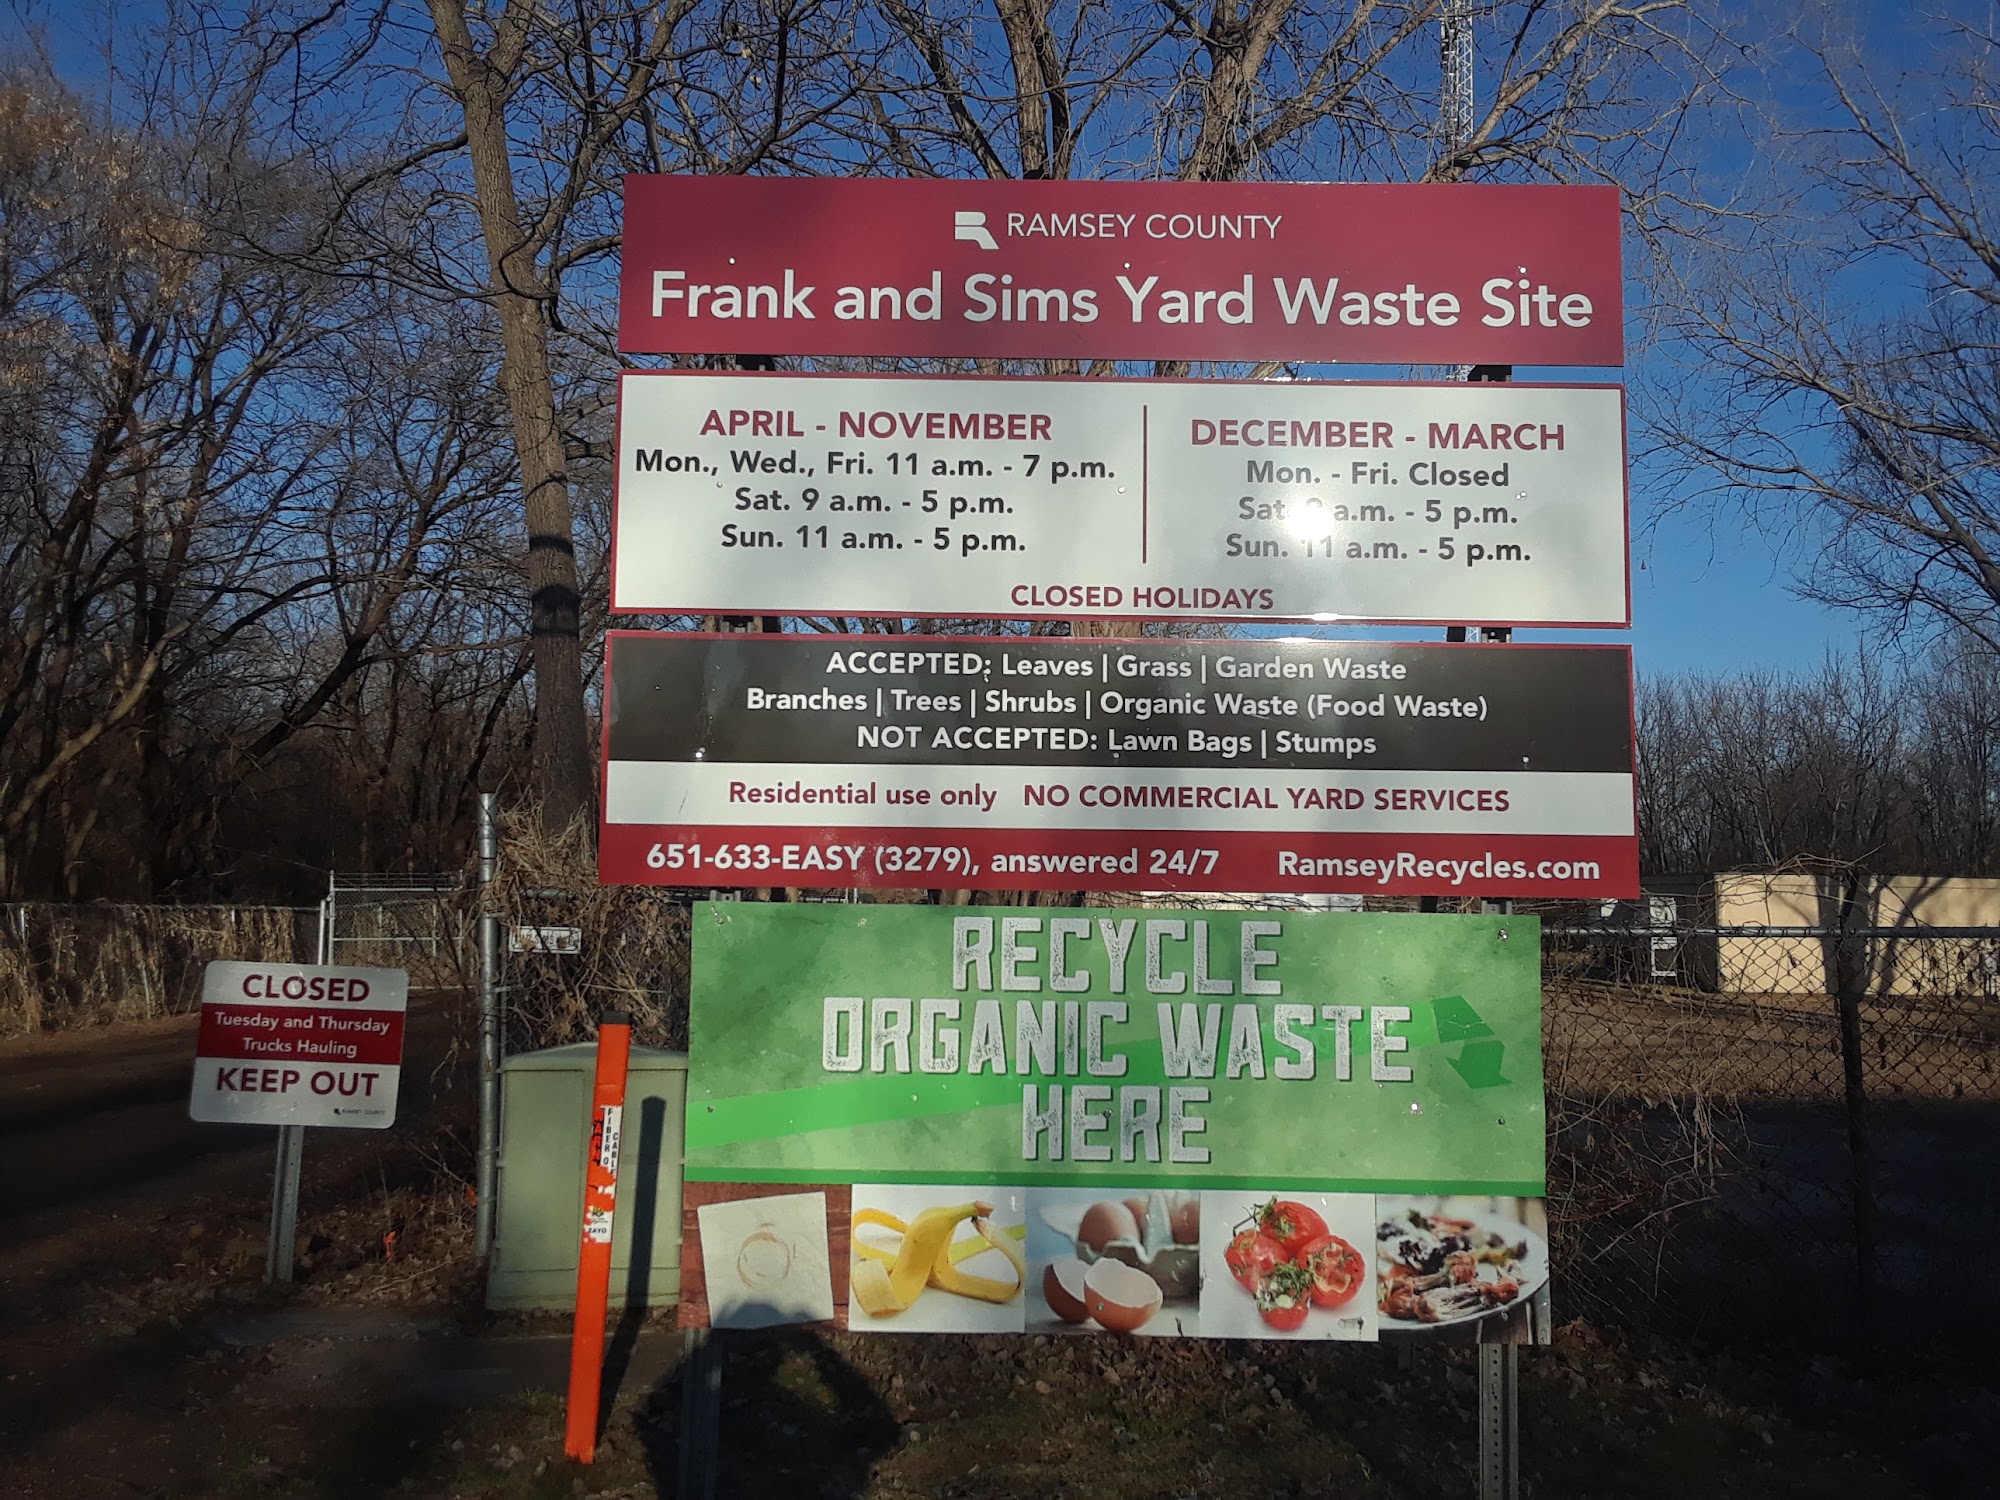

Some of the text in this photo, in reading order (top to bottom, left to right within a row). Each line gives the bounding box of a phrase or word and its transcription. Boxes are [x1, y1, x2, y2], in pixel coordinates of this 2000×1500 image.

[1009, 213, 1135, 237] RAMSEY
[1146, 214, 1282, 238] COUNTY
[653, 269, 1592, 327] Frank and Sims Yard Waste Site
[700, 410, 804, 436] APRIL
[840, 412, 1051, 440] NOVEMBER
[1192, 420, 1393, 448] DECEMBER
[1429, 423, 1564, 450] MARCH
[636, 449, 717, 476] Mon.,
[730, 450, 814, 477] Wed.,
[828, 452, 873, 474] Fri.
[887, 453, 917, 475] 11
[932, 460, 992, 476] a.m.
[1023, 455, 1039, 476] 7
[1052, 462, 1114, 484] p.m.
[1248, 460, 1320, 483] Mon.
[1352, 462, 1397, 484] Fri.
[1410, 462, 1508, 486] Closed
[736, 487, 789, 510] Sat.
[802, 488, 819, 510] 9
[830, 495, 890, 511] a.m.
[922, 490, 937, 512] 5
[951, 497, 1012, 519] p.m.
[1334, 501, 1394, 522] a.m.
[1426, 500, 1441, 522] 5
[1454, 507, 1517, 529] p.m.
[722, 524, 782, 547] Sun.
[797, 526, 827, 548] 11
[842, 533, 902, 549] a.m.
[934, 527, 949, 550] 5
[963, 535, 1025, 557] p.m.
[1226, 533, 1287, 557] Sun.
[1346, 539, 1407, 560] a.m.
[1439, 537, 1454, 559] 5
[1467, 544, 1530, 567] p.m.
[1012, 585, 1274, 610] CLOSED HOLIDAYS
[826, 652, 991, 675] ACCEPTED:
[1002, 654, 1093, 676] Leaves
[1116, 655, 1191, 678] Grass
[1214, 656, 1313, 680] Garden
[1323, 658, 1406, 681] Waste
[748, 687, 867, 710] Branches
[891, 689, 961, 712] Trees
[986, 689, 1076, 712] Shrubs
[1101, 692, 1205, 719] Organic
[1214, 693, 1298, 718] Waste
[1308, 694, 1384, 719] (Food
[1394, 695, 1486, 720] Waste)
[858, 726, 923, 747] NOT
[932, 727, 1096, 749] ACCEPTED:
[1109, 729, 1177, 750] Lawn
[1189, 730, 1252, 758] Bags
[1276, 731, 1376, 759] Stumps
[730, 781, 1509, 812] Residential use only NO COMMERCIAL YARD SERVICES
[647, 844, 1599, 885] 651-633-EASY (3279), answered 24/7 RamseyRecycles.com
[953, 916, 1283, 997] RECYCLE
[243, 974, 370, 1002] CLOSED
[216, 1012, 389, 1035] Tuesday and Thursday
[243, 1038, 356, 1058] Trucks Hauling
[823, 997, 1414, 1082] ORGANIC WASTE
[216, 1067, 379, 1096] KEEP OUT
[605, 1108, 613, 1151] FIBER
[1019, 1082, 1211, 1165] HERE
